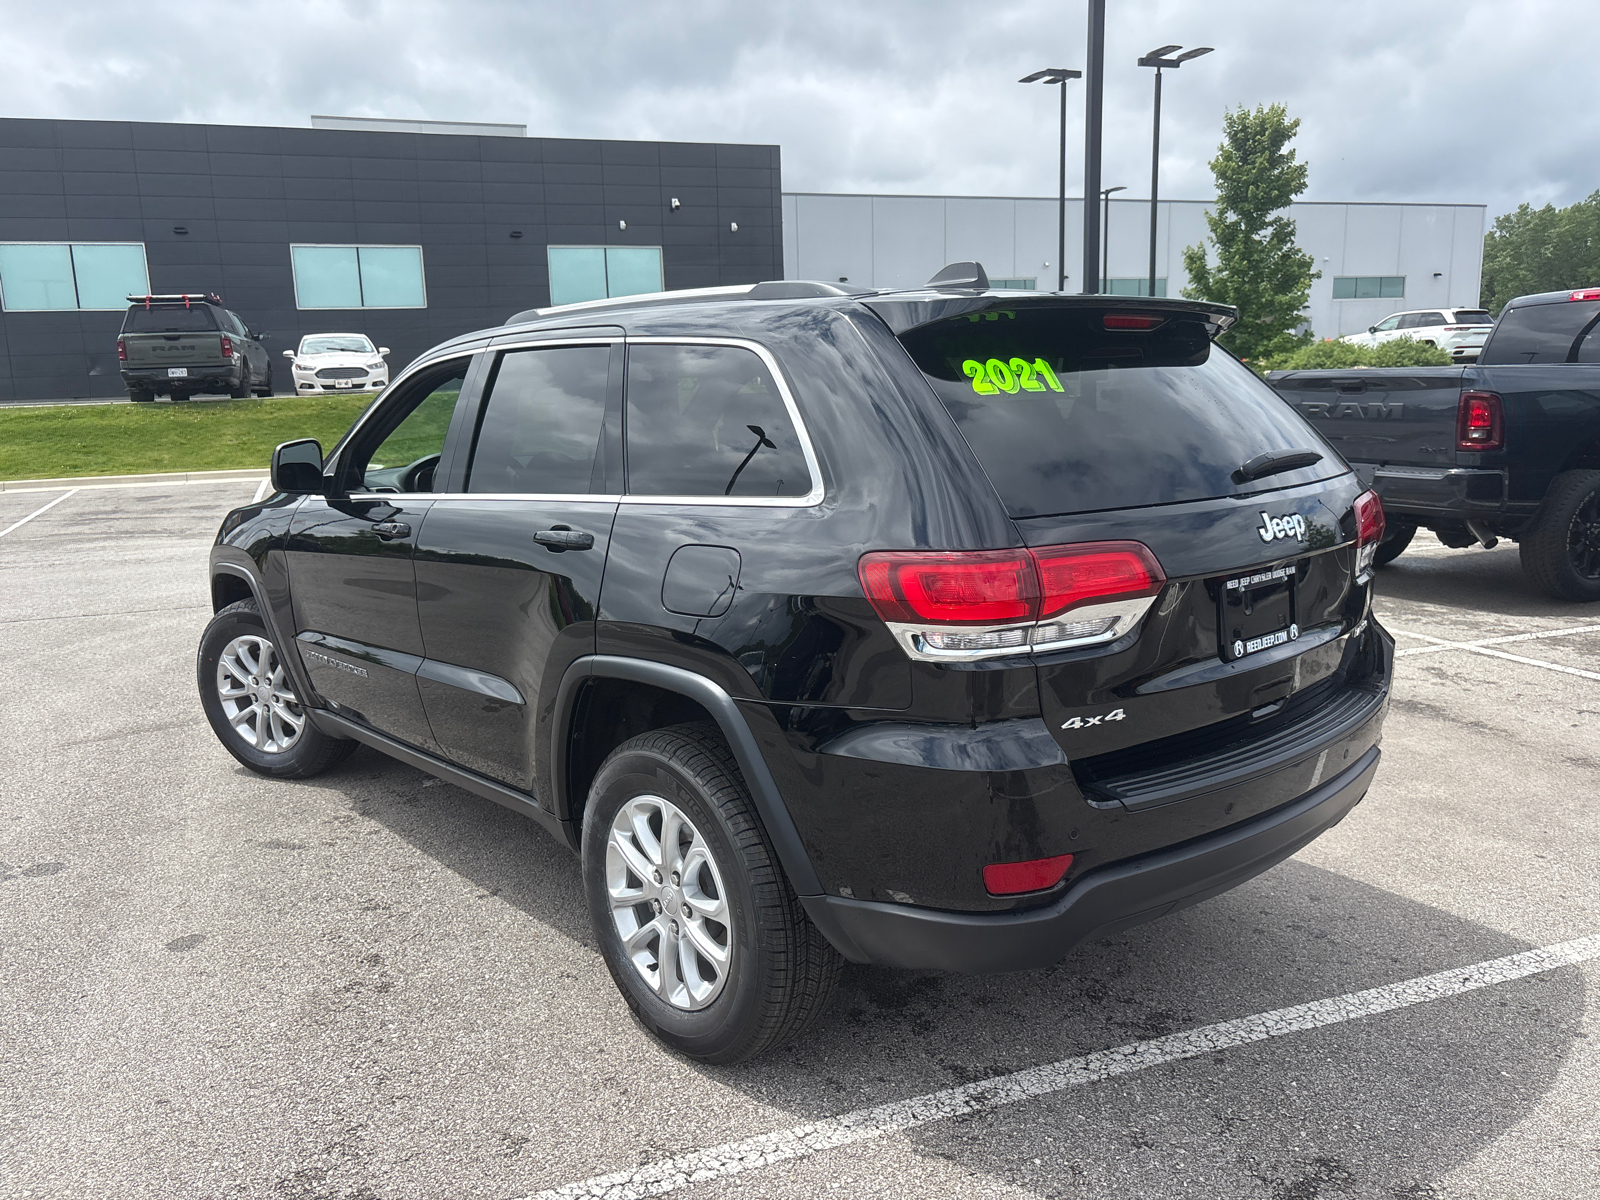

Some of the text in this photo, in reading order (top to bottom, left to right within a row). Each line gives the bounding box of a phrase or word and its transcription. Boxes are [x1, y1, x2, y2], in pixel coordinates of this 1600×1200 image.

[962, 357, 1065, 395] 2021
[1301, 402, 1405, 420] RAM
[1257, 511, 1306, 543] Jeep
[1226, 580, 1239, 589] REED
[1239, 576, 1250, 586] JEEP
[1250, 571, 1272, 584] CHRYSLER
[1272, 568, 1285, 579] DODGE
[1246, 631, 1288, 653] REEDJEEP.COM
[678, 790, 727, 864] MICHELIN
